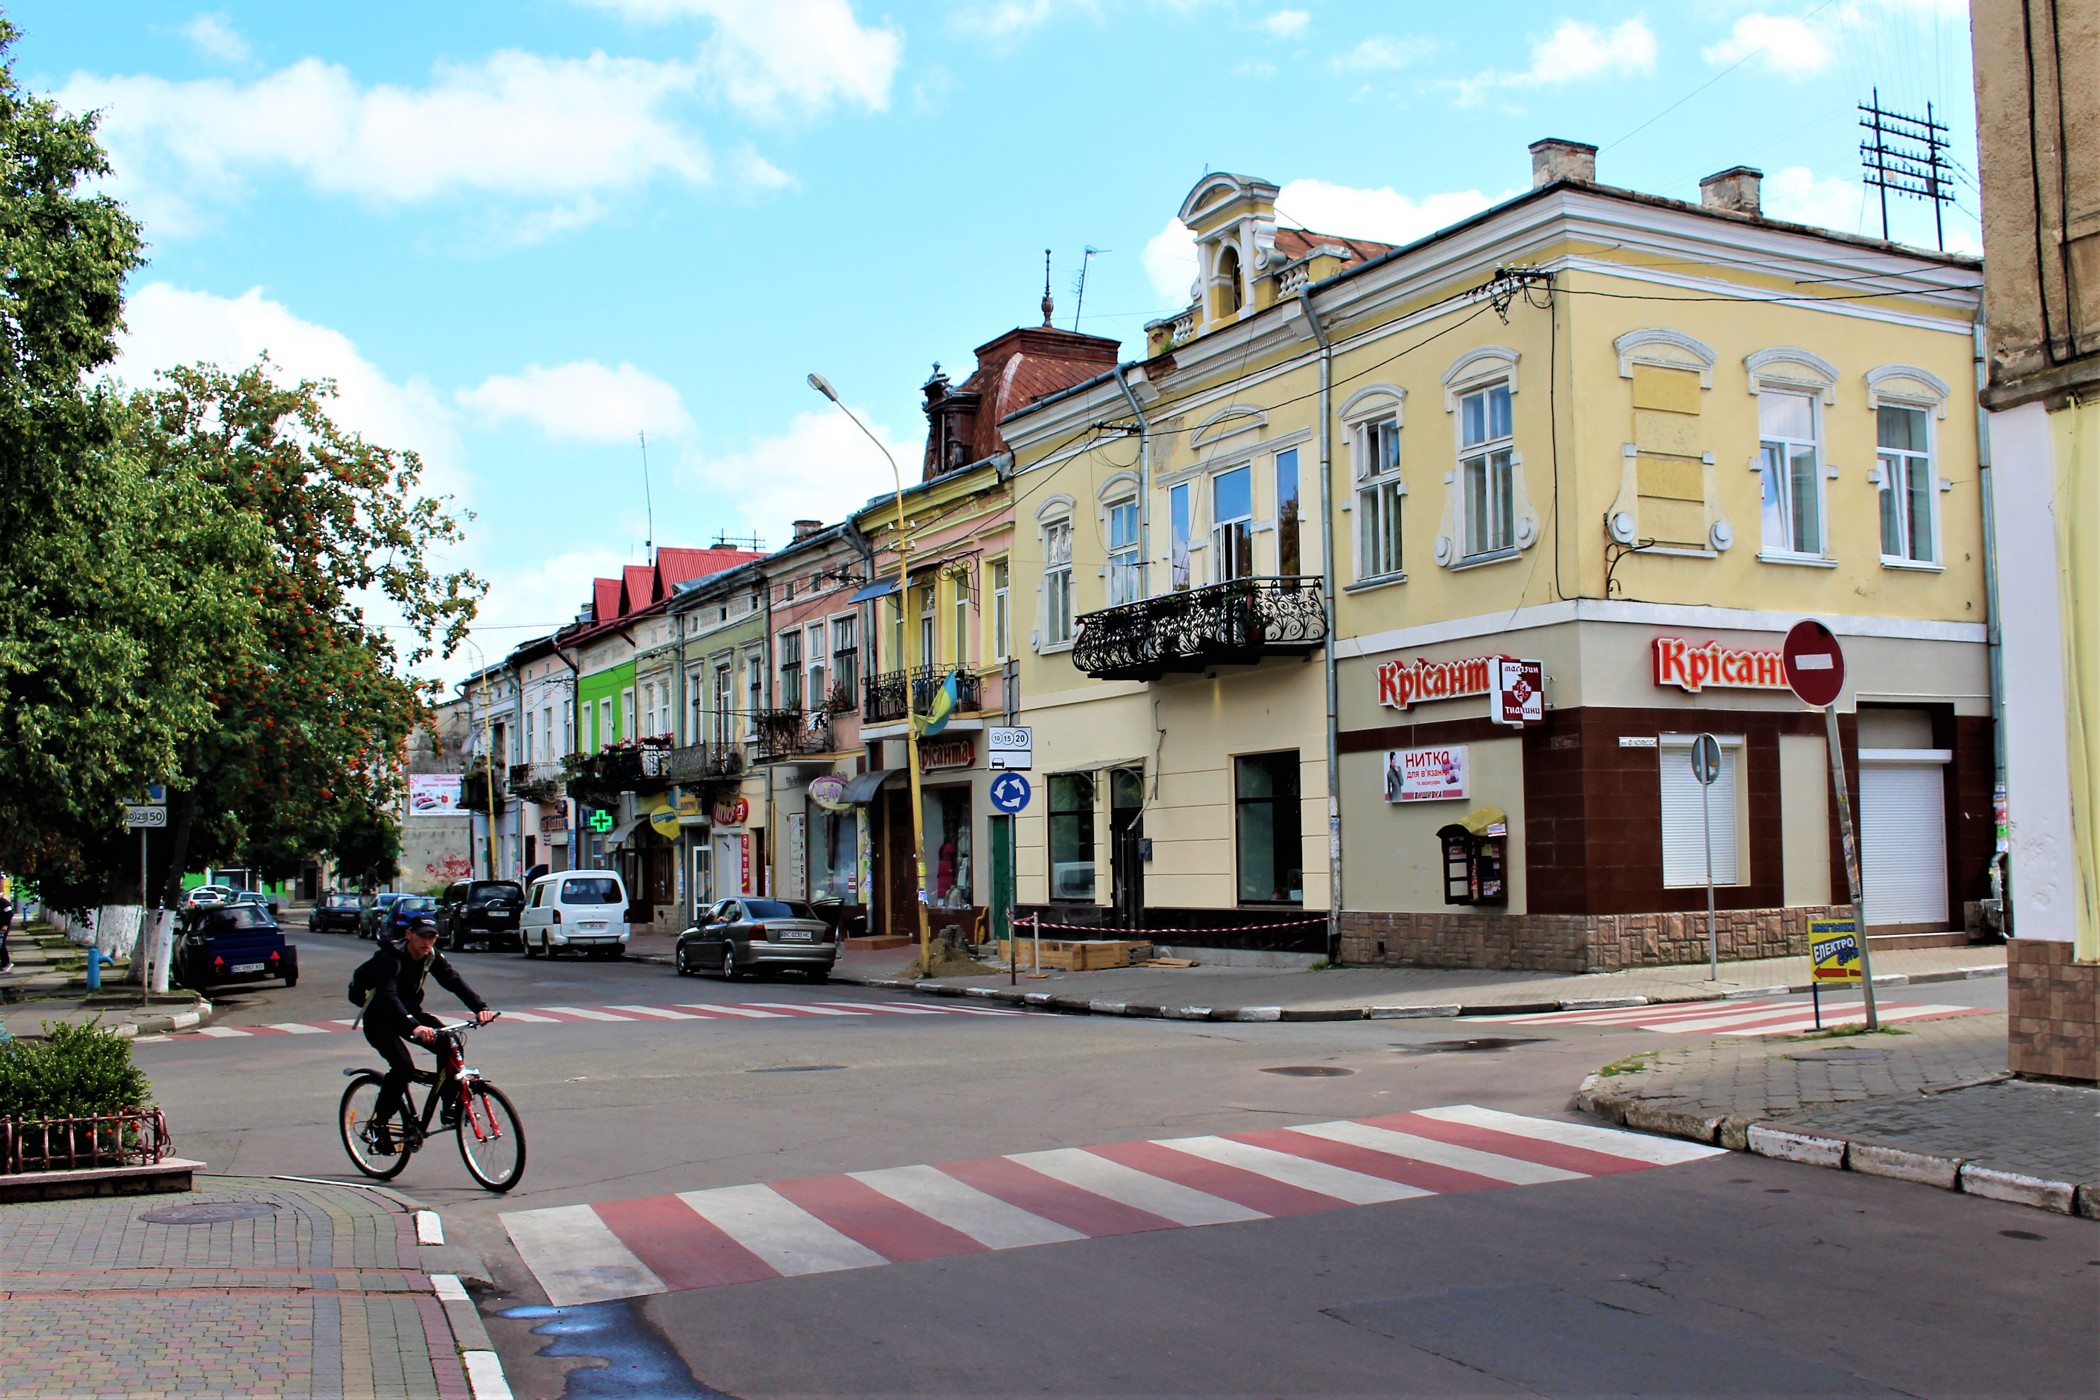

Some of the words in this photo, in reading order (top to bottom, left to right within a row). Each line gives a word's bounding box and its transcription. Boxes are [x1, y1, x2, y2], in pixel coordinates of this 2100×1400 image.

[1658, 638, 1792, 690] Крісан
[1504, 665, 1539, 674] магазин
[1378, 660, 1491, 708] Крісант
[1504, 706, 1541, 715] тканини
[1015, 734, 1025, 743] 20
[919, 741, 969, 773] рісанта
[1406, 771, 1420, 780] для
[1415, 790, 1442, 799] ВИШИВКА
[149, 812, 162, 821] 50
[1813, 937, 1855, 963] ЕЛЕКТРО
